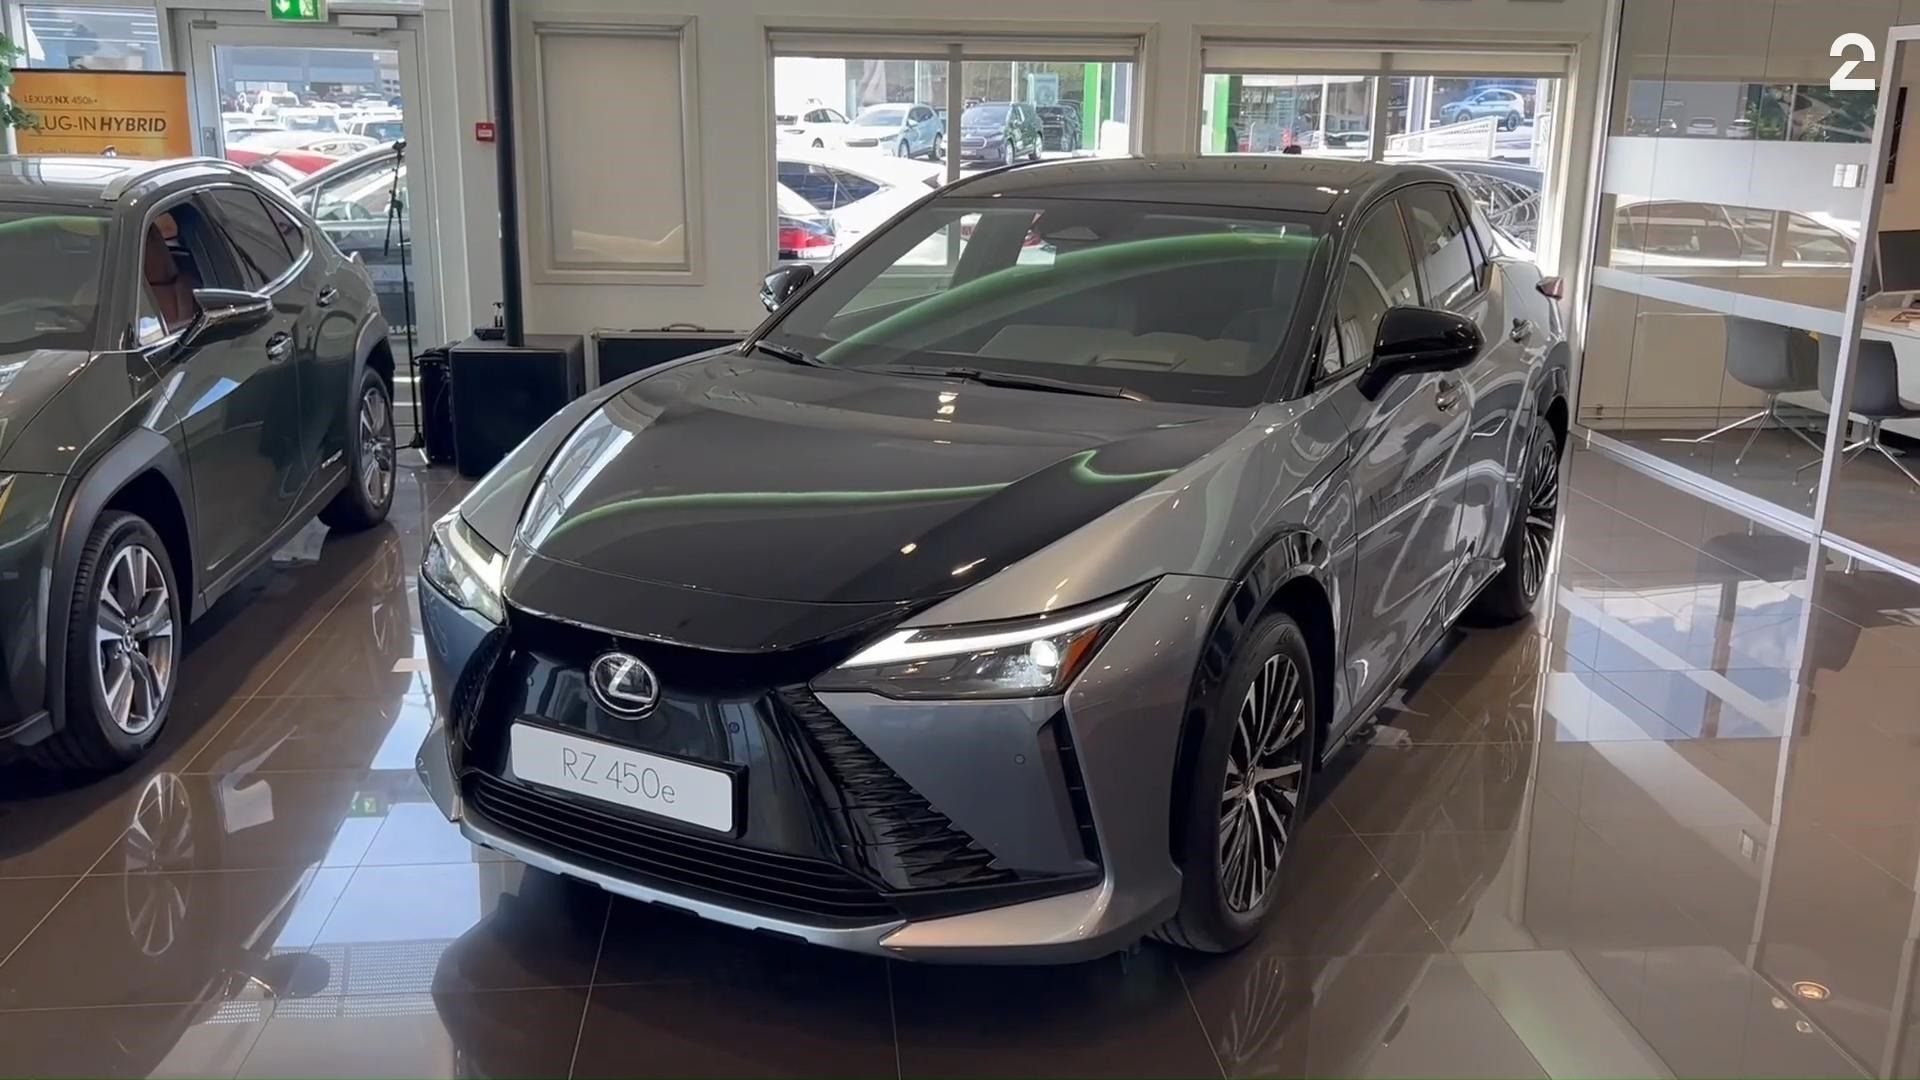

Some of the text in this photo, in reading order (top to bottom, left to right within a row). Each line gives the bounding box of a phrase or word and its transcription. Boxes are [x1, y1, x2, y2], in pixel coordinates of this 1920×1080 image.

[24, 94, 53, 104] LEXUS
[54, 95, 70, 105] NX
[38, 115, 167, 132] UG-IN HYBRID
[561, 746, 676, 804] RZ 450e
